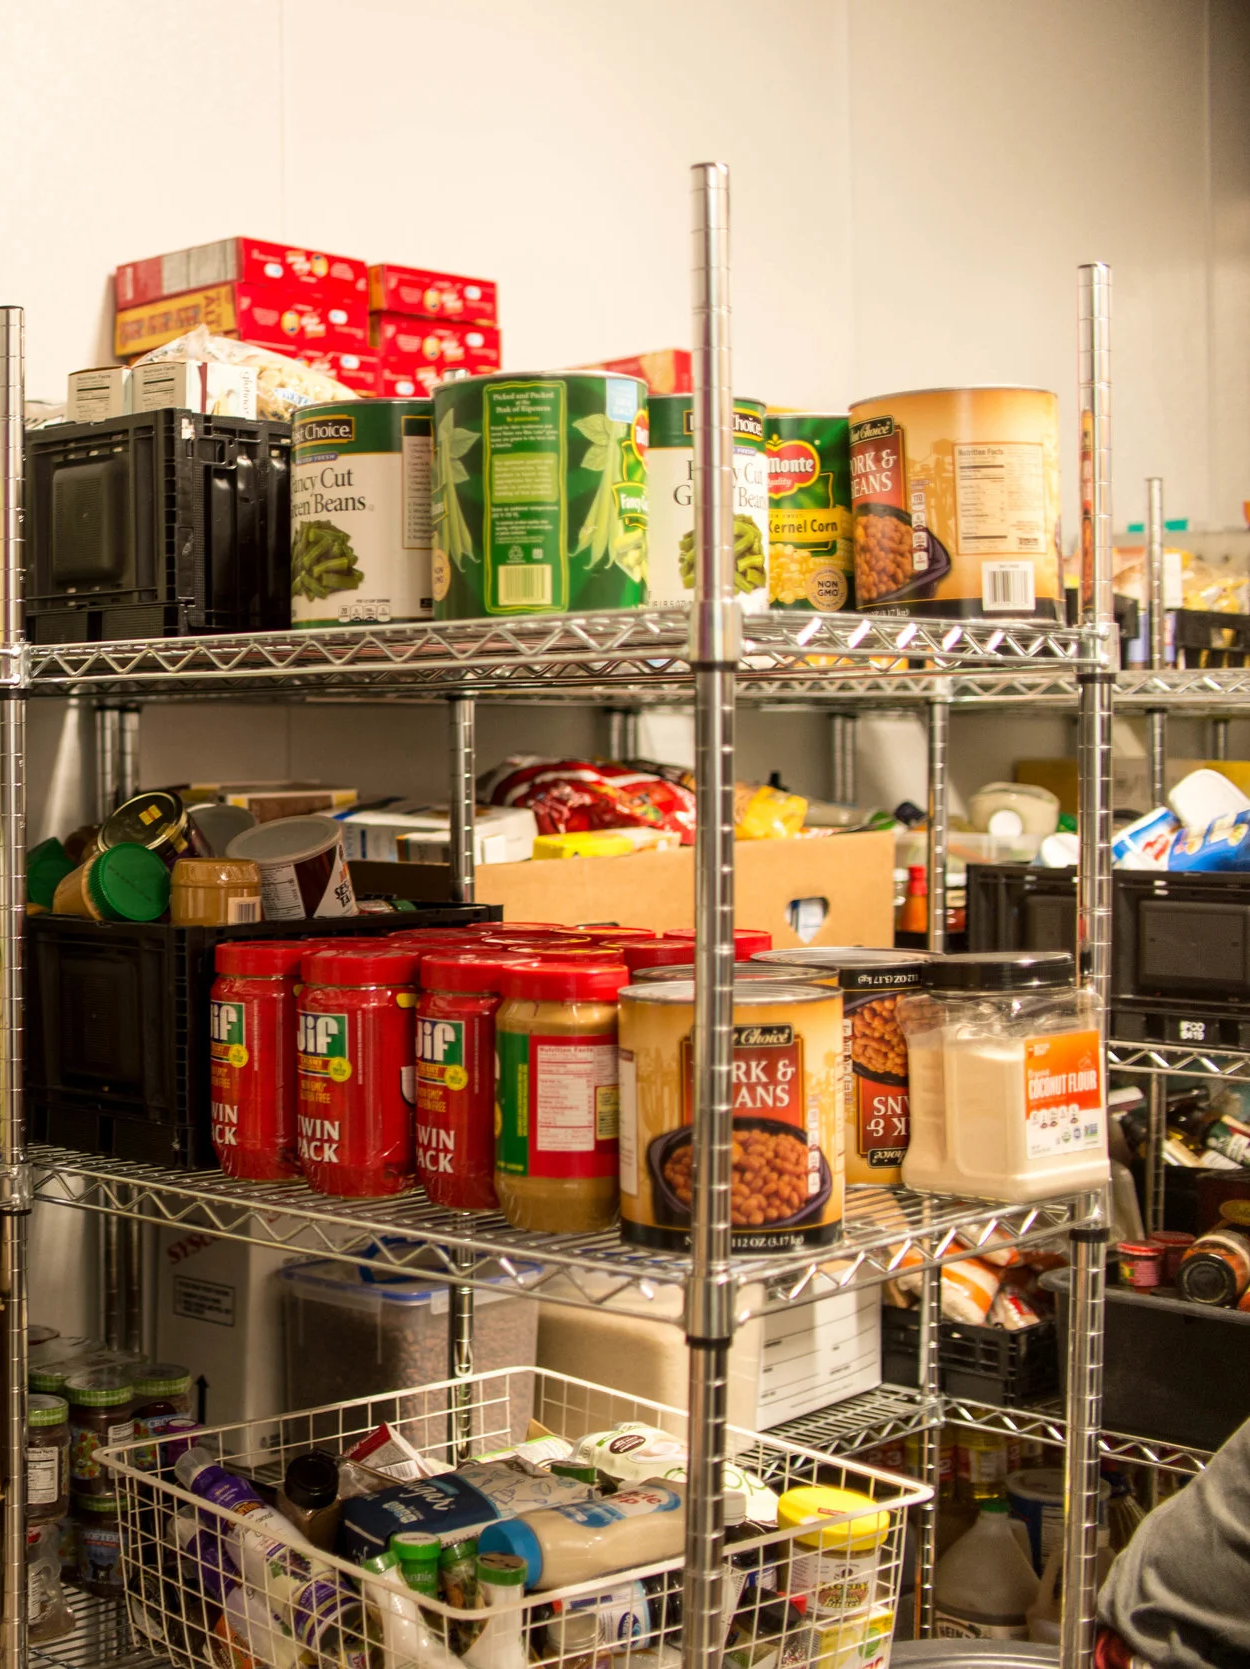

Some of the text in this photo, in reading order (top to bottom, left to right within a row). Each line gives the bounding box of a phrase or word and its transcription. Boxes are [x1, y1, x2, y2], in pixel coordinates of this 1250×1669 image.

[860, 424, 890, 438] Choice
[769, 457, 814, 473] Monte
[851, 449, 897, 477] ORK &
[292, 467, 354, 494] ancy Cut
[311, 493, 366, 514] Beans
[810, 519, 838, 533] Corn
[817, 581, 838, 589] NON
[817, 589, 838, 597] GMO
[297, 1014, 338, 1054] Jif
[741, 1028, 789, 1045] Choice
[732, 1059, 796, 1083] RK &
[1029, 1070, 1098, 1099] COCONUT FLOUR
[734, 1085, 790, 1108] ANS
[417, 1124, 455, 1150] WIN
[867, 1118, 884, 1136] &
[417, 1151, 454, 1173] ACK
[750, 1237, 766, 1248] OZ
[767, 1235, 789, 1247] (3.17
[790, 1234, 805, 1248] kg)
